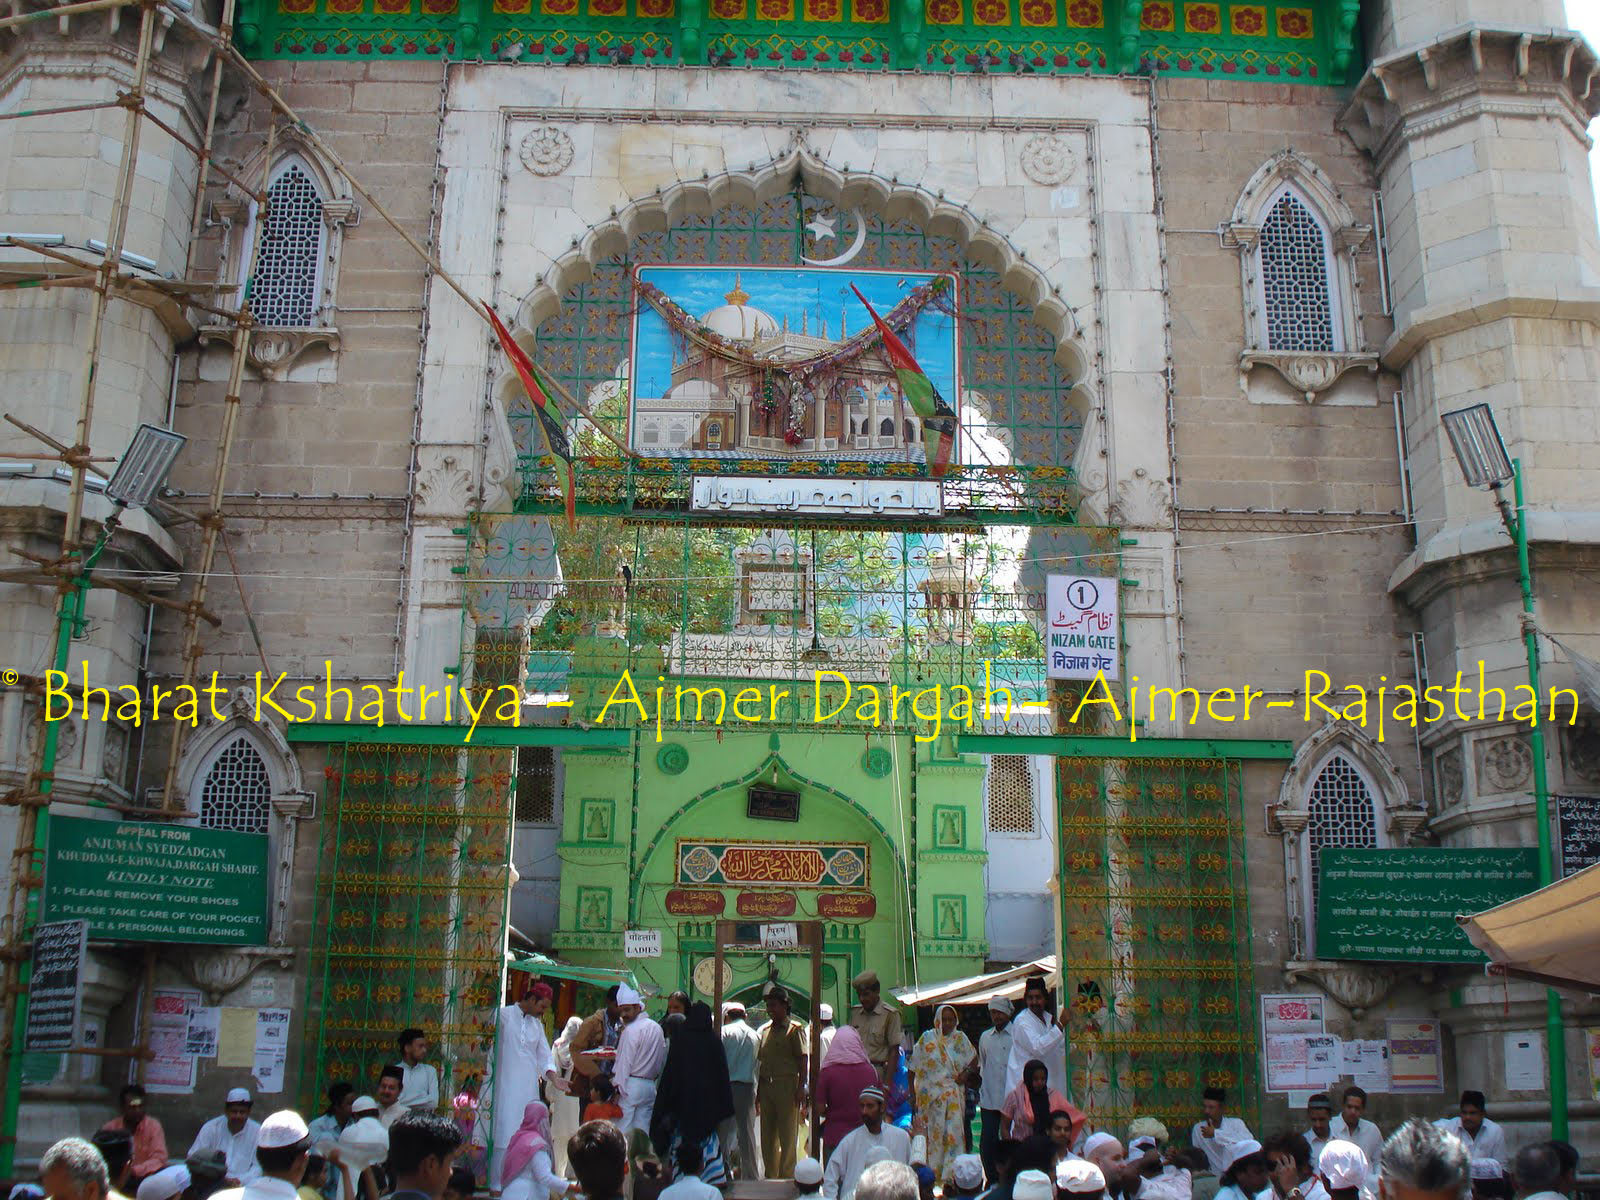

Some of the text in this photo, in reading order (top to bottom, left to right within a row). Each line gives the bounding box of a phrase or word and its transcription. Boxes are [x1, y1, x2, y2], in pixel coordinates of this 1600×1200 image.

[1052, 610, 1114, 632] نظام گیٹ
[1051, 633, 1116, 650] NIZAM GATE
[1052, 651, 1113, 671] निजाम गेट
[116, 825, 191, 841] APPEAL FROM
[83, 837, 226, 859] ANJUMAN SYEDZADGAN
[106, 870, 216, 889] KINDLY NOTE
[64, 887, 111, 899] PLEASE
[114, 890, 164, 902] REMOVE
[166, 894, 198, 905] YOUR
[201, 896, 240, 906] SHOES
[63, 905, 107, 915] PLEASE
[110, 907, 137, 917] TAKE
[140, 909, 169, 919] CARE
[171, 911, 186, 920] OF
[188, 912, 217, 922] YOUR
[108, 921, 116, 930] &
[118, 922, 176, 934] PERSONAL
